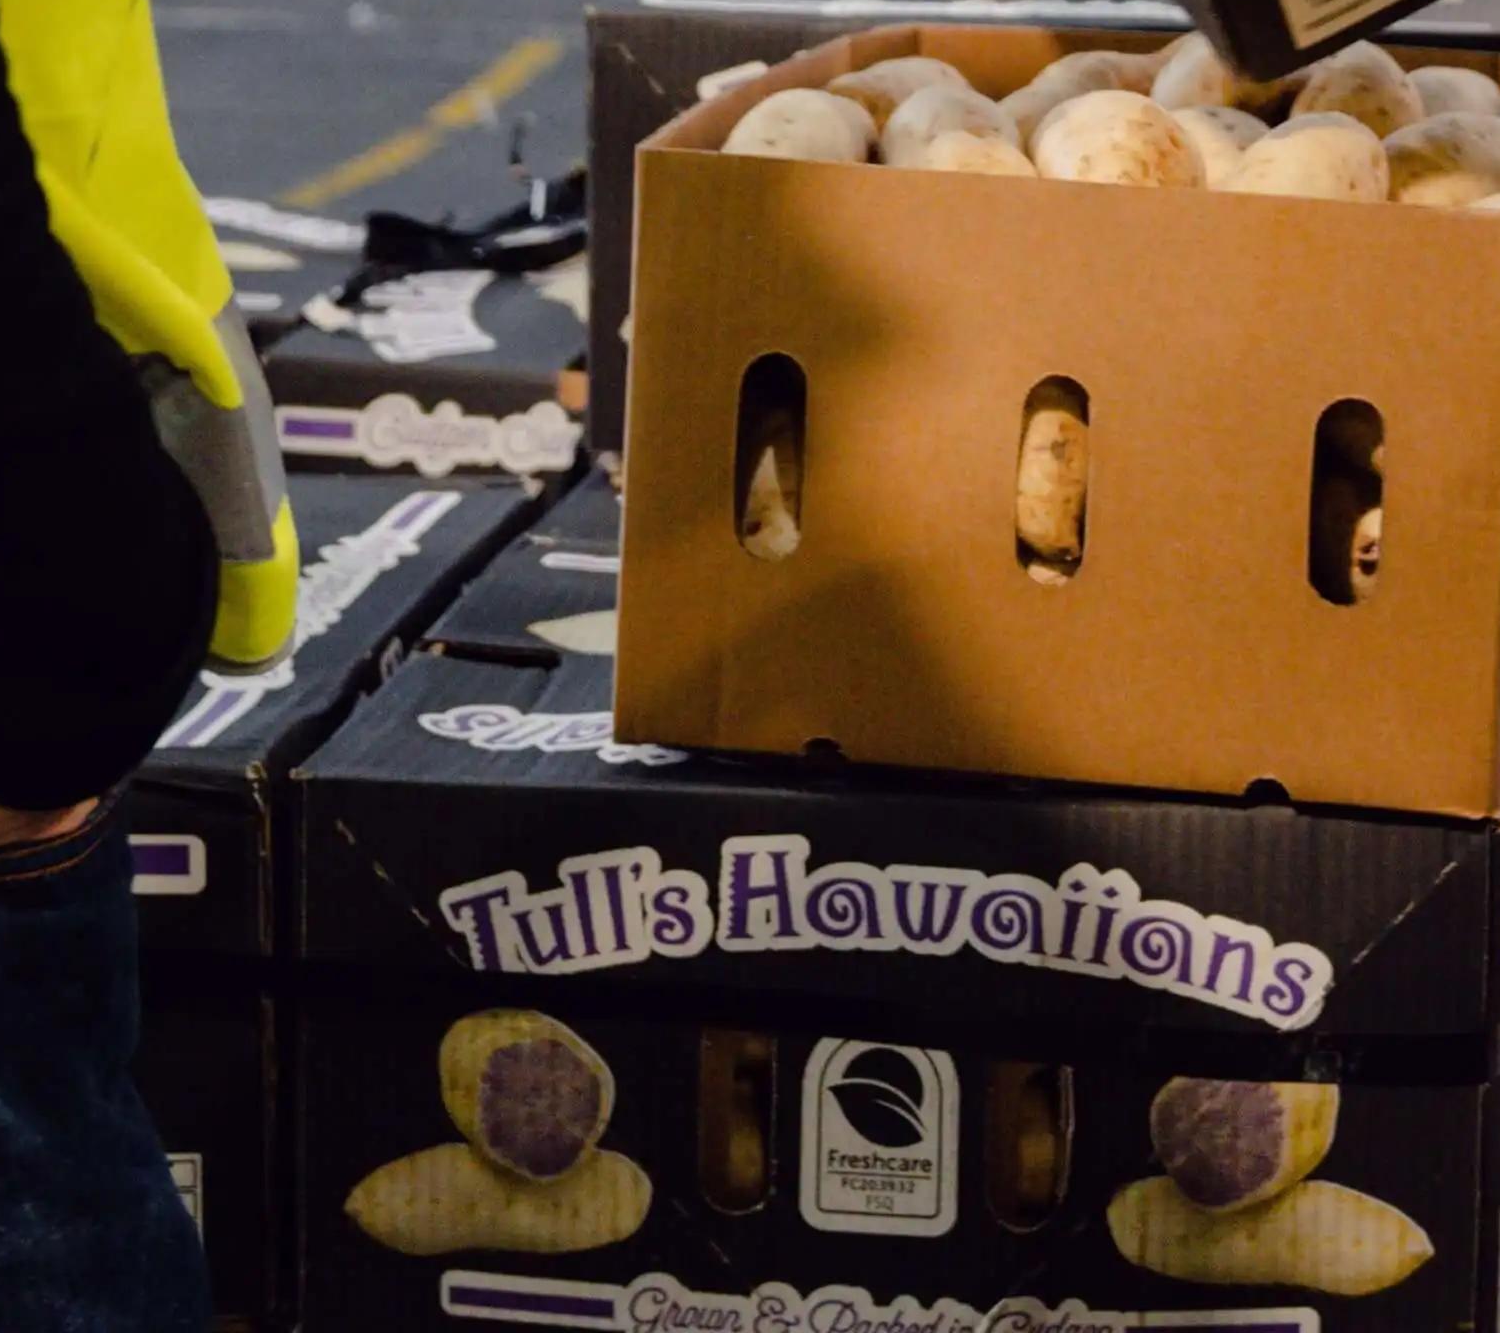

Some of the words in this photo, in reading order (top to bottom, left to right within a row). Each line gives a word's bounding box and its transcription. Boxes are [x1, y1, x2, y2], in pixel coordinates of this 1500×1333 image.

[447, 860, 698, 971] Tull's
[722, 847, 1318, 1021] Hawaiians
[826, 1148, 933, 1173] Freshcare
[628, 1286, 742, 1333] Grown
